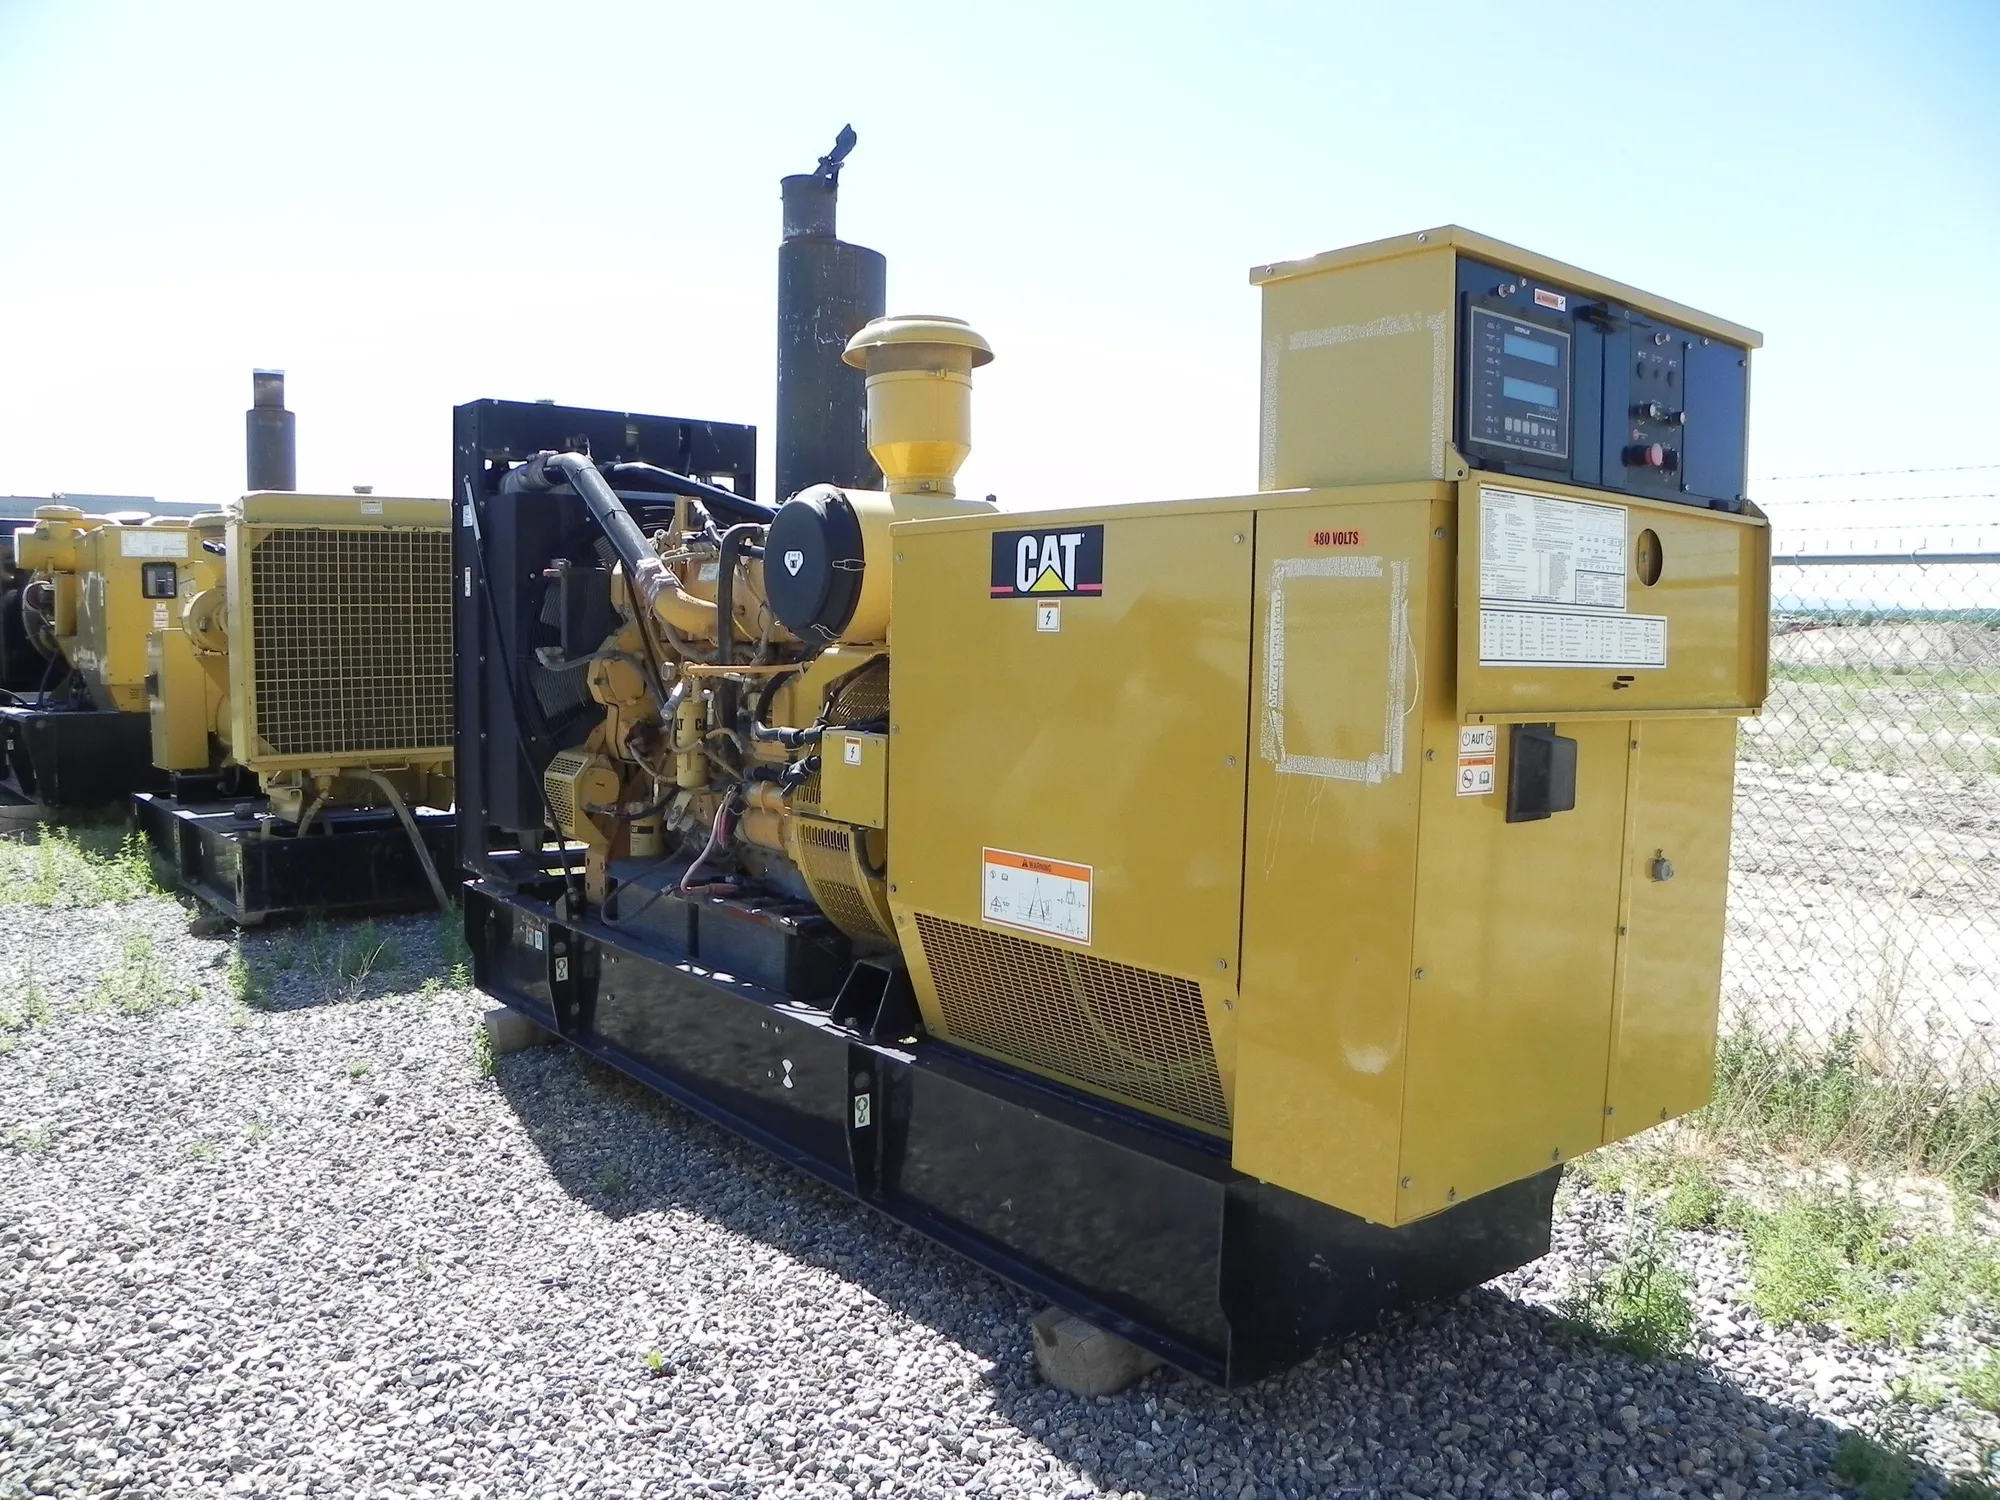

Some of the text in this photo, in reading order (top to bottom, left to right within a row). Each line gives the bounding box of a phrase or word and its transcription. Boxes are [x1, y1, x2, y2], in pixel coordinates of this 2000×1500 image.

[1314, 531, 1359, 545] 480 VOLTS
[1016, 533, 1082, 593] CAT
[1471, 733, 1484, 744] AUT
[1029, 861, 1052, 873] WARNING
